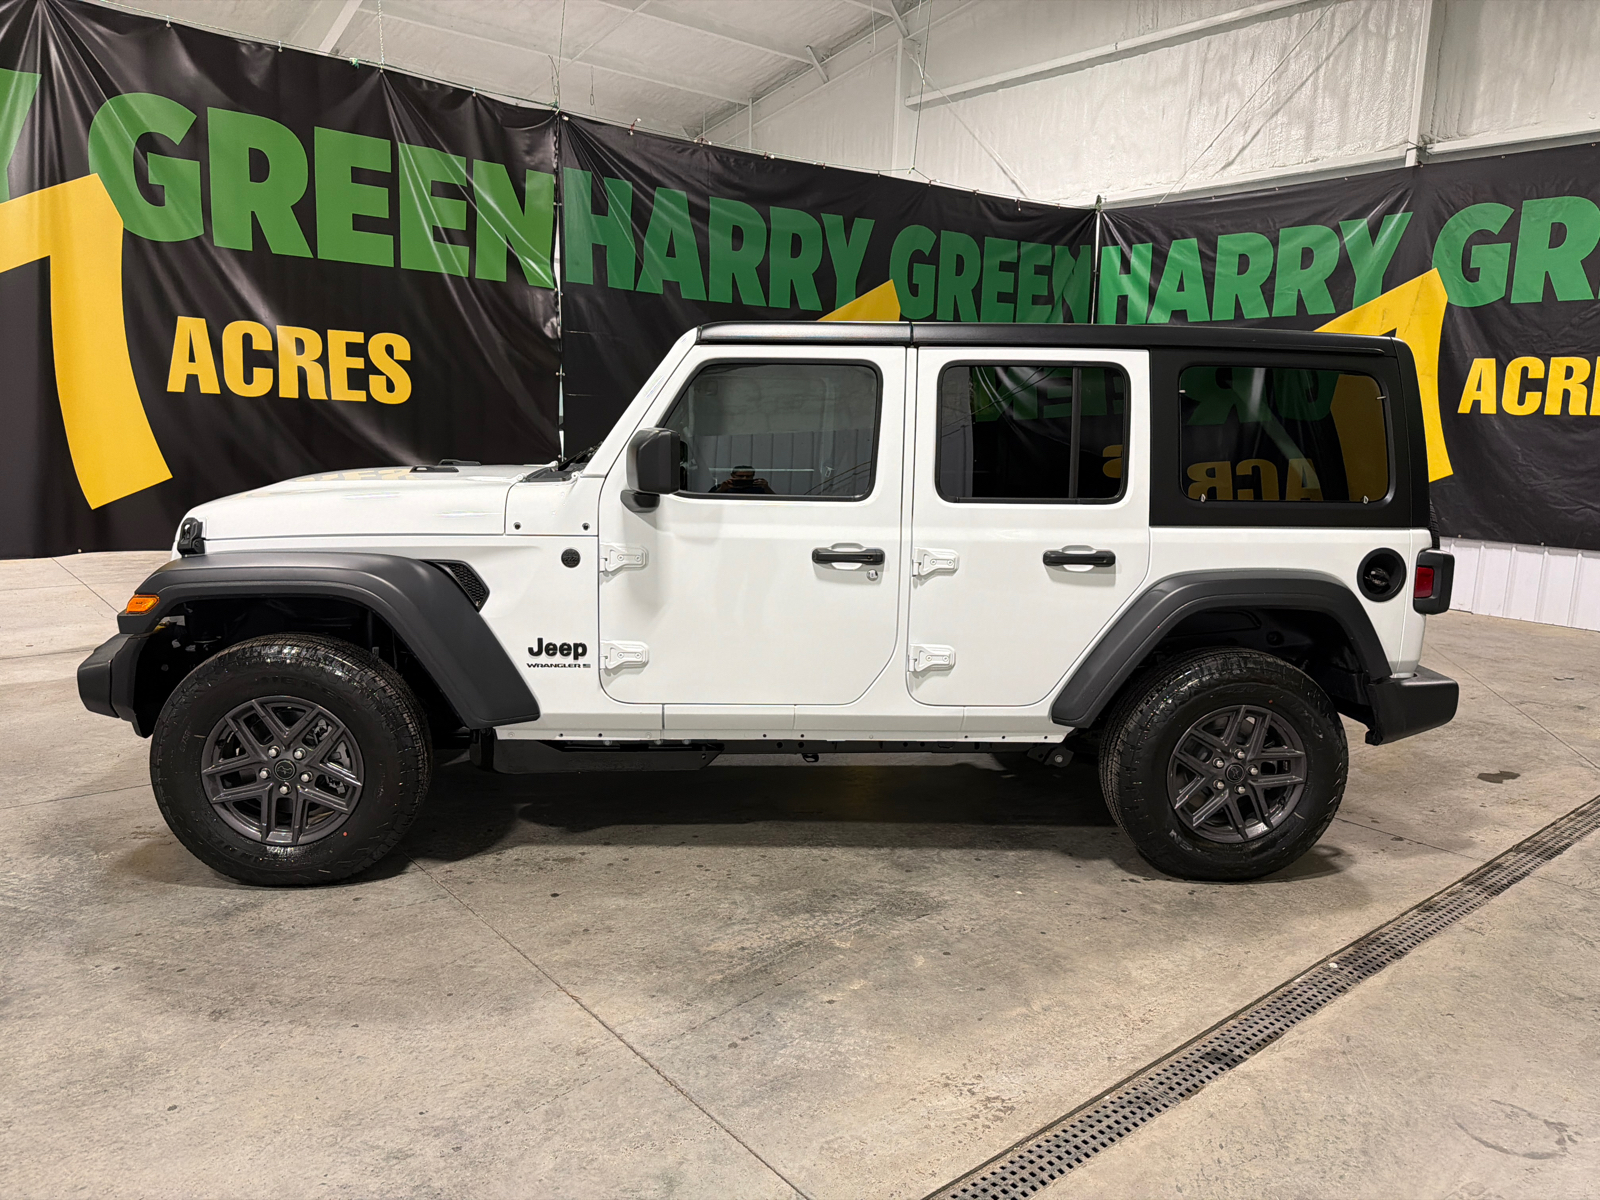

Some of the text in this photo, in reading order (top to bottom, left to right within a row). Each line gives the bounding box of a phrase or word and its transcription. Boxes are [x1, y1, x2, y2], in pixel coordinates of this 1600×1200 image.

[88, 92, 555, 289] GREEN
[563, 167, 1093, 323] HARRY GREEN
[1096, 195, 1600, 324] HARRY GR
[166, 315, 413, 404] ACRES
[528, 637, 588, 661] Jeep
